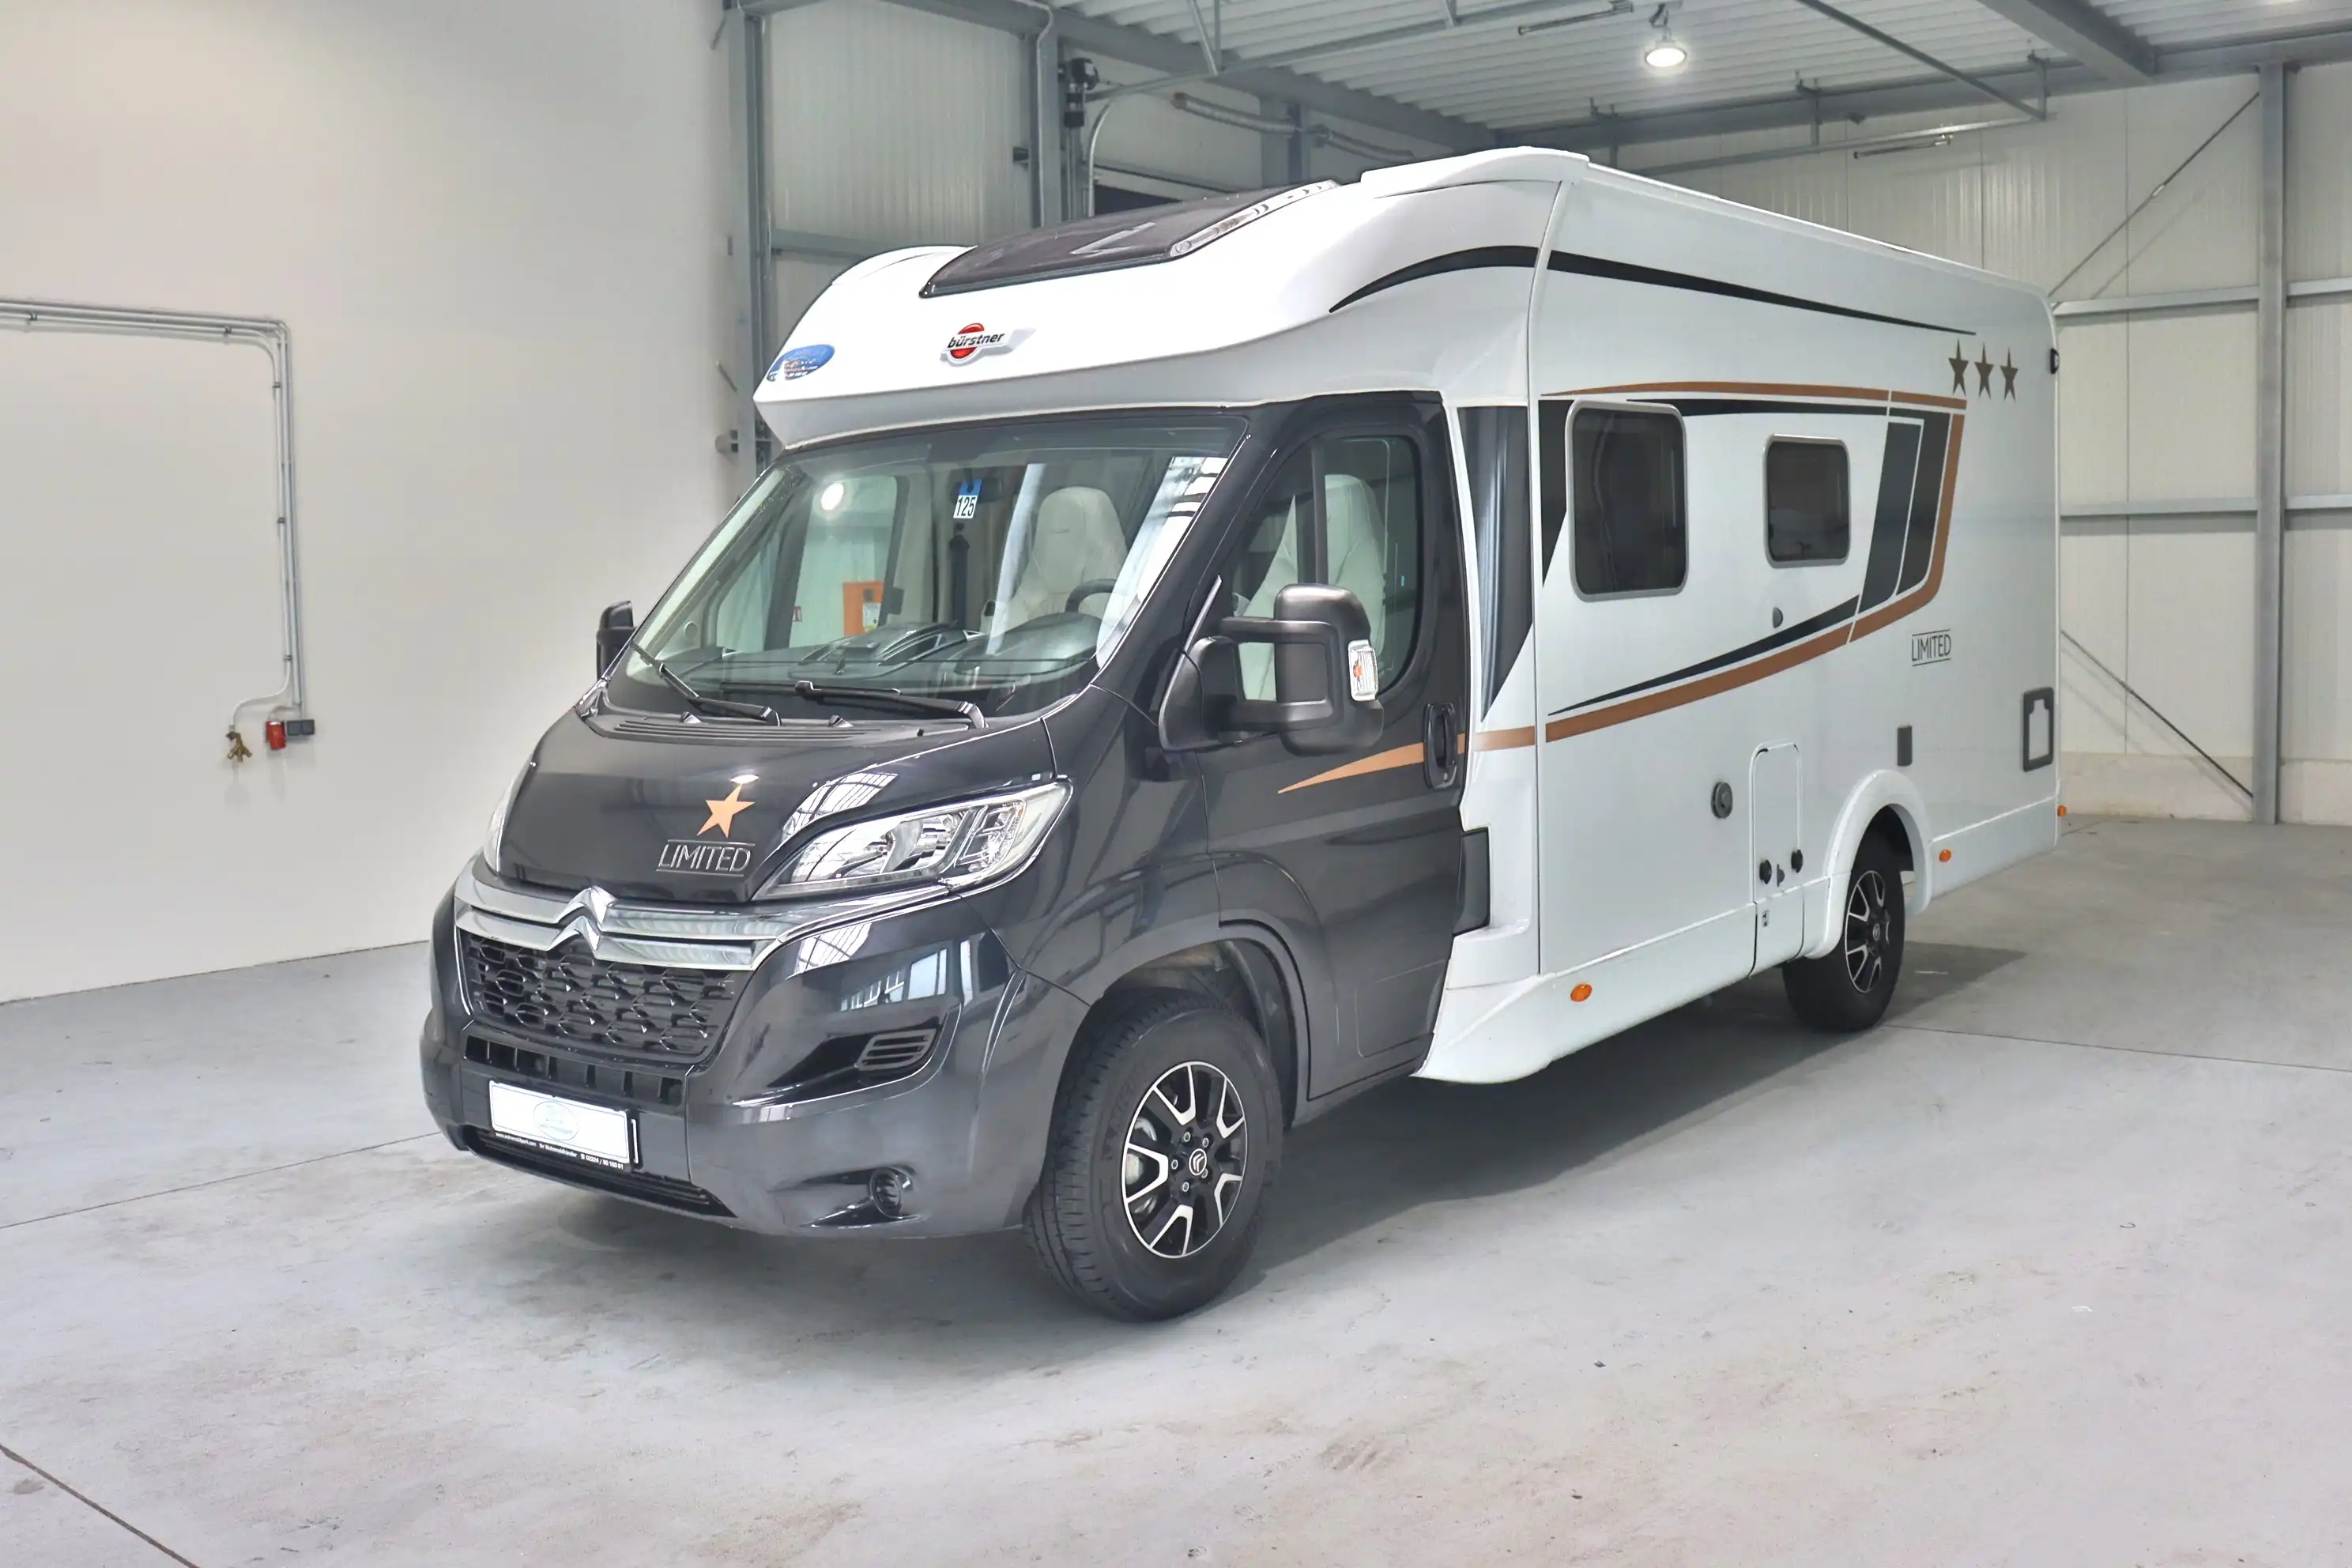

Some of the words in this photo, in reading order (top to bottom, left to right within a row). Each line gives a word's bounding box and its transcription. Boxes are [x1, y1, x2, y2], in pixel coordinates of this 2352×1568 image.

[948, 333, 1005, 349] bürstner
[957, 496, 976, 517] 125
[1911, 634, 1952, 662] LIMITED
[658, 843, 751, 872] LIMITED
